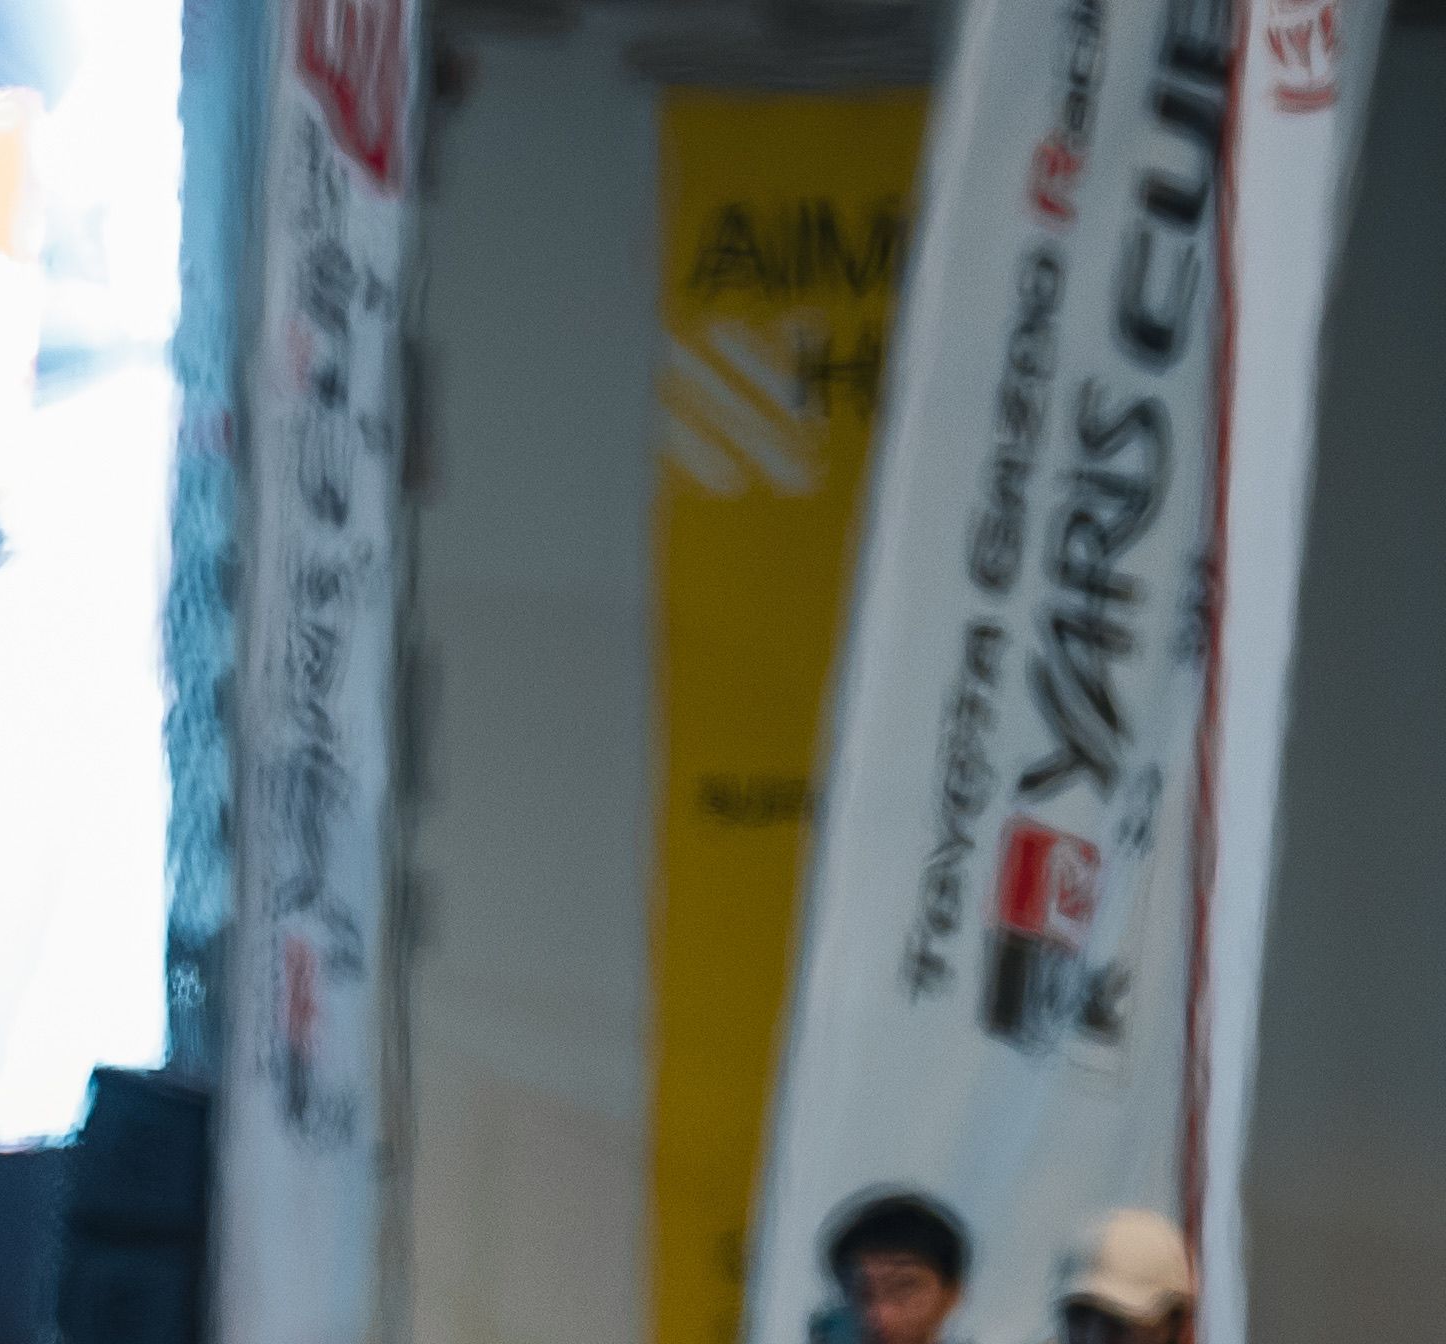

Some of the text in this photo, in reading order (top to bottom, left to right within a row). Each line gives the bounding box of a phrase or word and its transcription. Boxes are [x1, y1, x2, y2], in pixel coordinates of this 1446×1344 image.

[900, 622, 1010, 1008] TOYOTA
[964, 247, 1065, 594] GAZOO
[1018, 374, 1175, 805] YARIS
